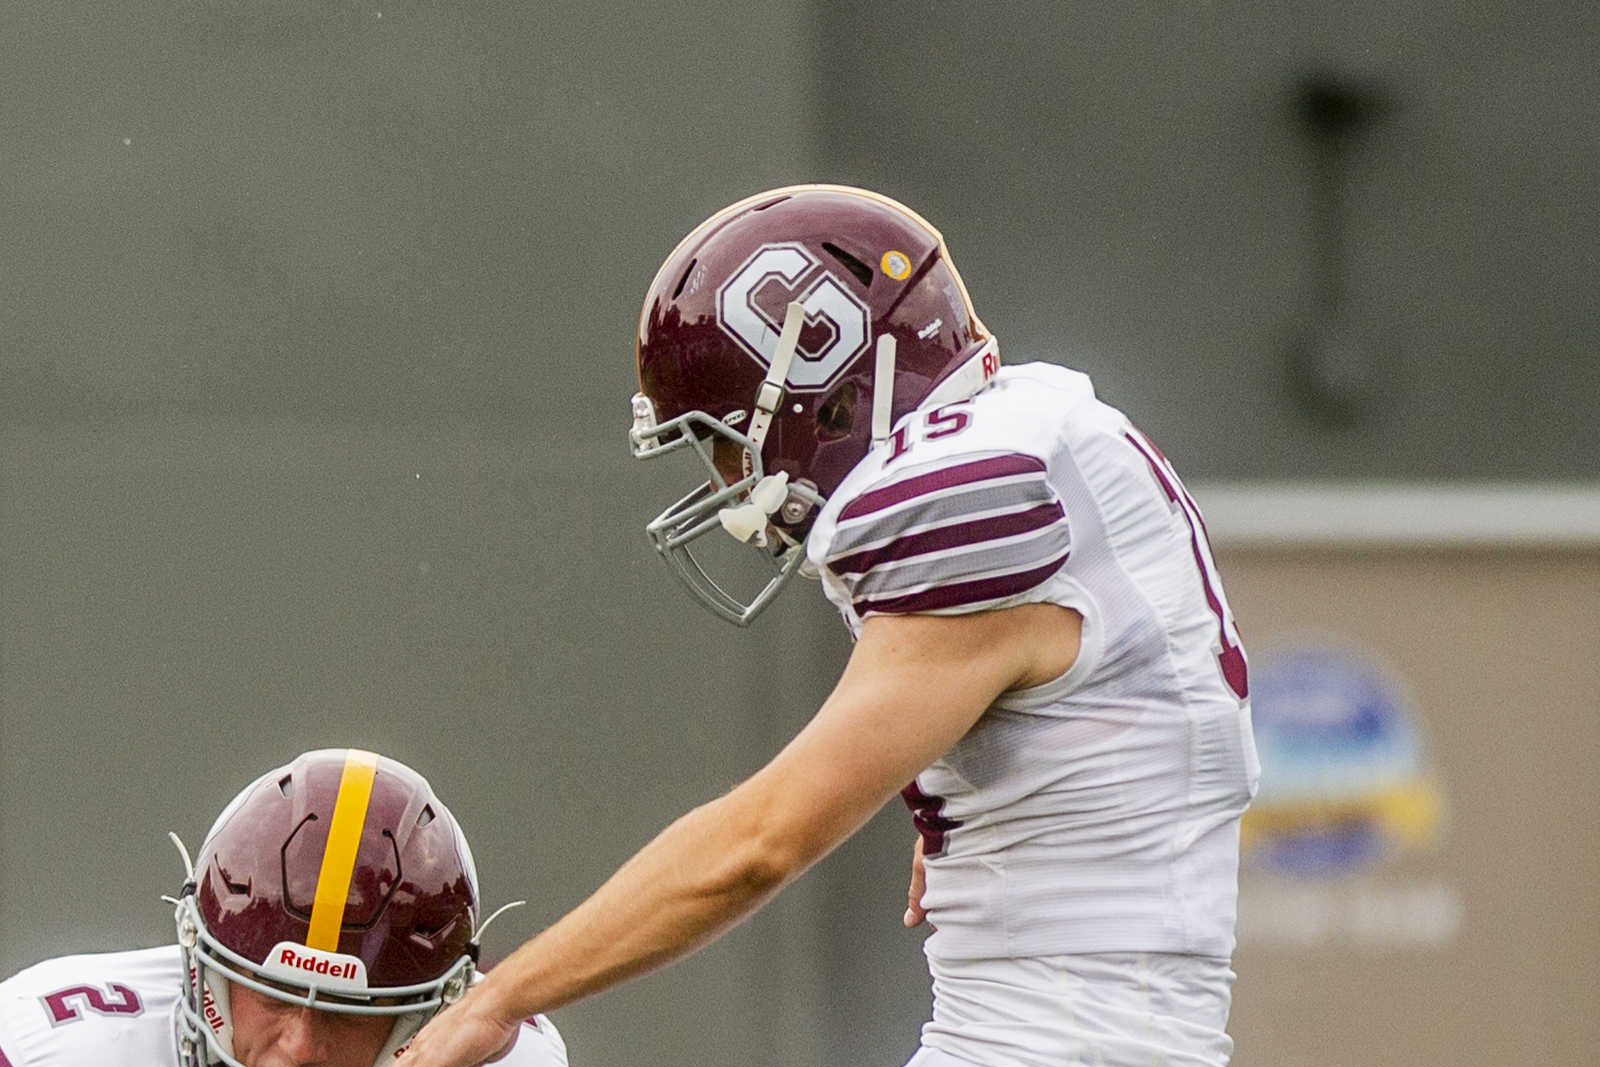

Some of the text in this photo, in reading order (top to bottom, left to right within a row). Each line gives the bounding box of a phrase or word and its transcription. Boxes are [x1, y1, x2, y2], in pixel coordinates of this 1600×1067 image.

[715, 241, 872, 393] G
[280, 949, 357, 979] Riddell
[37, 981, 145, 1029] 2
